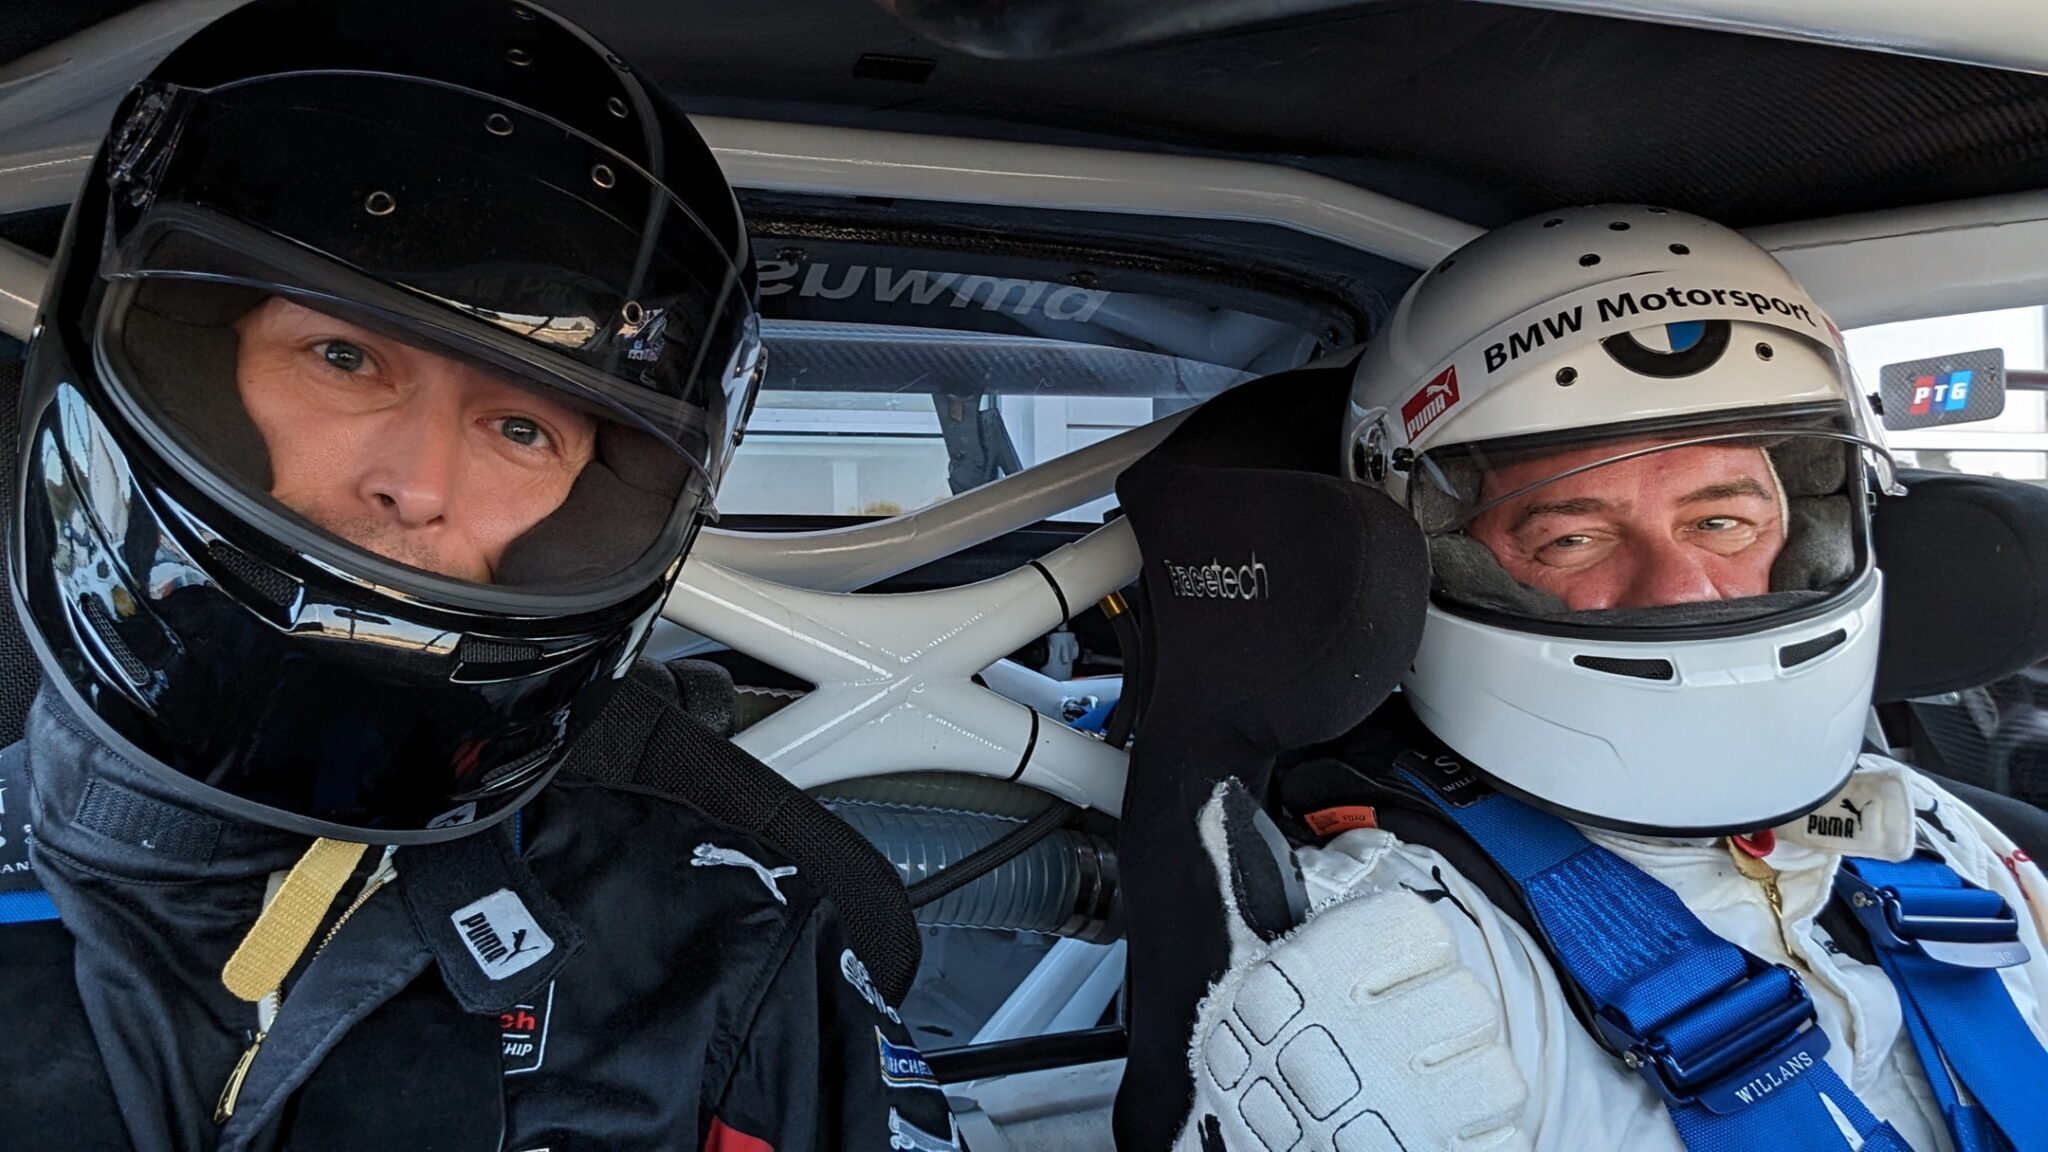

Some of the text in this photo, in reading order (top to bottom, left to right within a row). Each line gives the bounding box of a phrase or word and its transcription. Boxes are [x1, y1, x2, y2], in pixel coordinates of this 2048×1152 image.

[1484, 288, 1817, 374] BMW Motorsport
[1407, 393, 1446, 440] PUMA
[1164, 551, 1269, 600] Racetech
[1442, 775, 1476, 792] WILL
[1807, 814, 1854, 838] PUMA
[460, 911, 508, 964] PUMA
[1735, 1051, 1814, 1104] WILLANS
